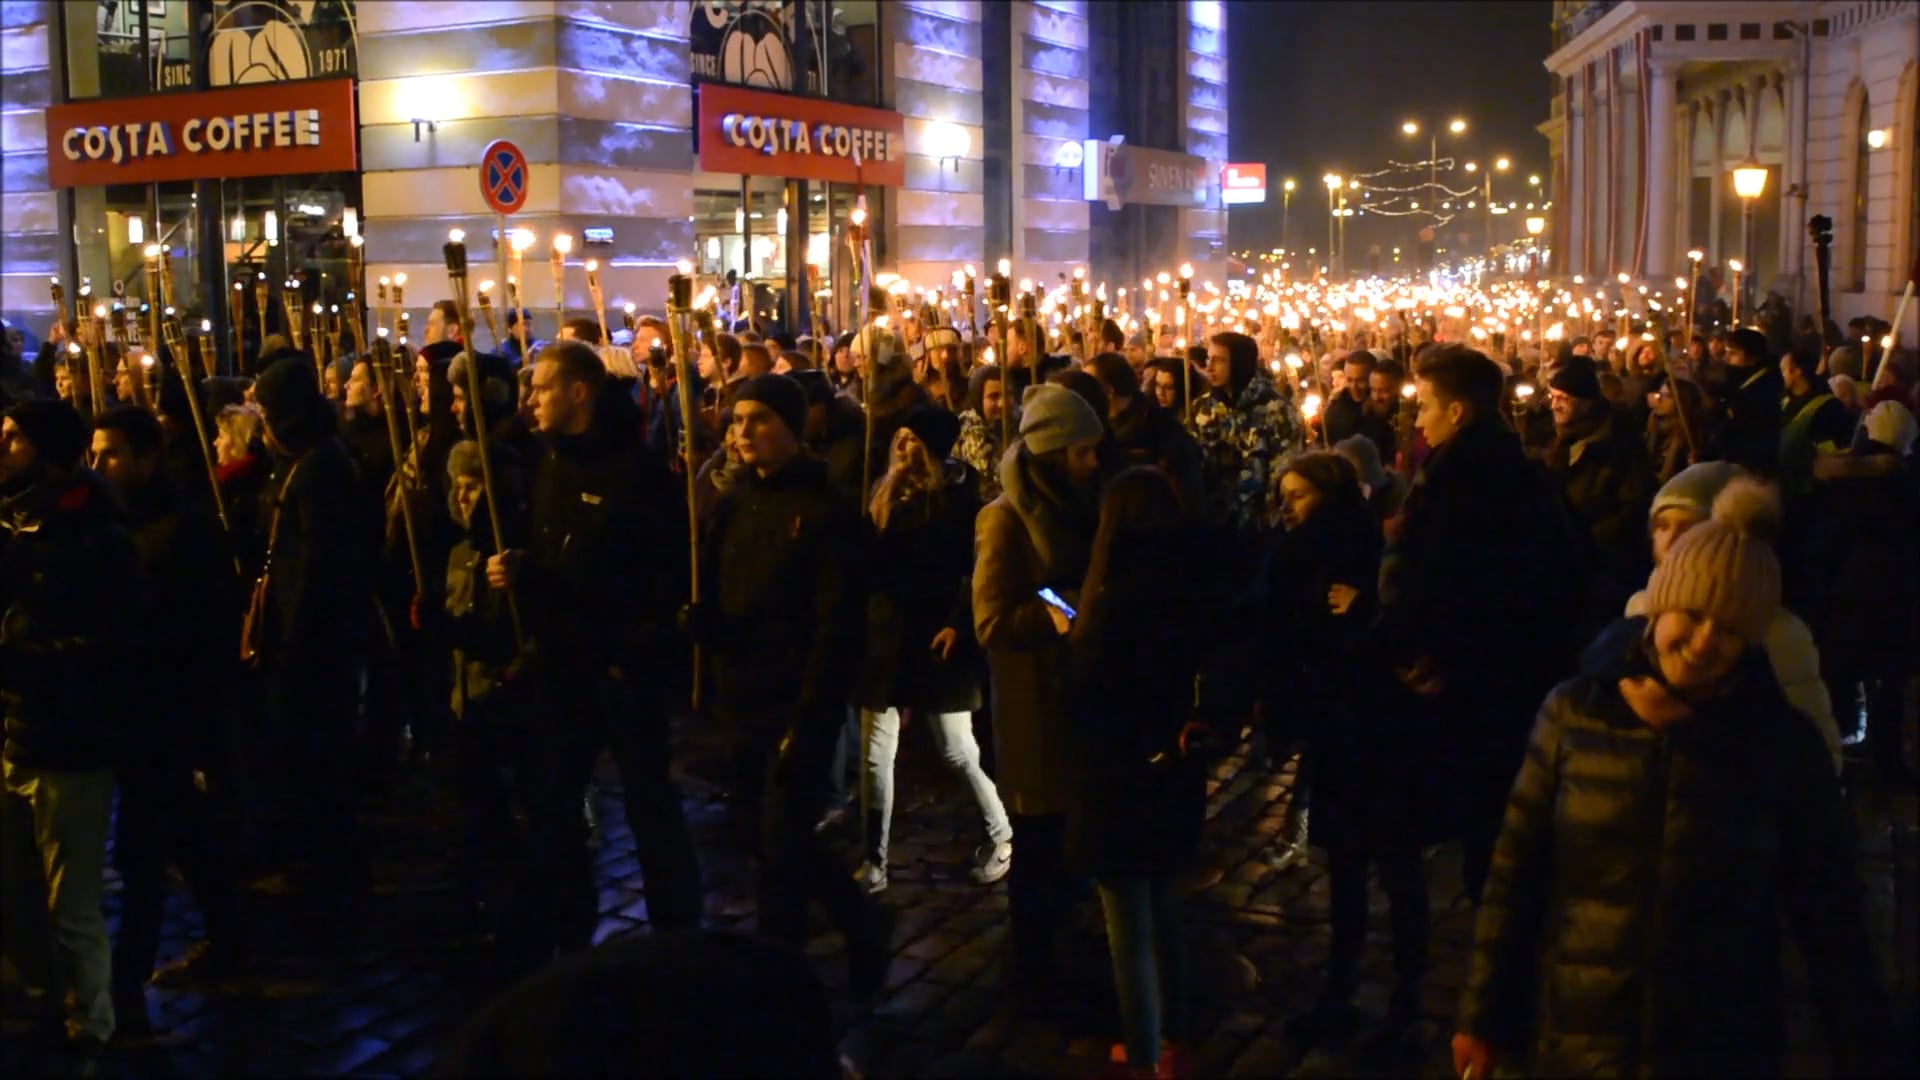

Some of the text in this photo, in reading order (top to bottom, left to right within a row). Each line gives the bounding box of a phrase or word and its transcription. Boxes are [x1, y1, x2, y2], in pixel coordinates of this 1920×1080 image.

[164, 48, 348, 87] SINC 1971
[689, 52, 716, 77] SINCE
[62, 109, 319, 165] COSTA COFFEE
[725, 113, 896, 161] COSTA COFFEE
